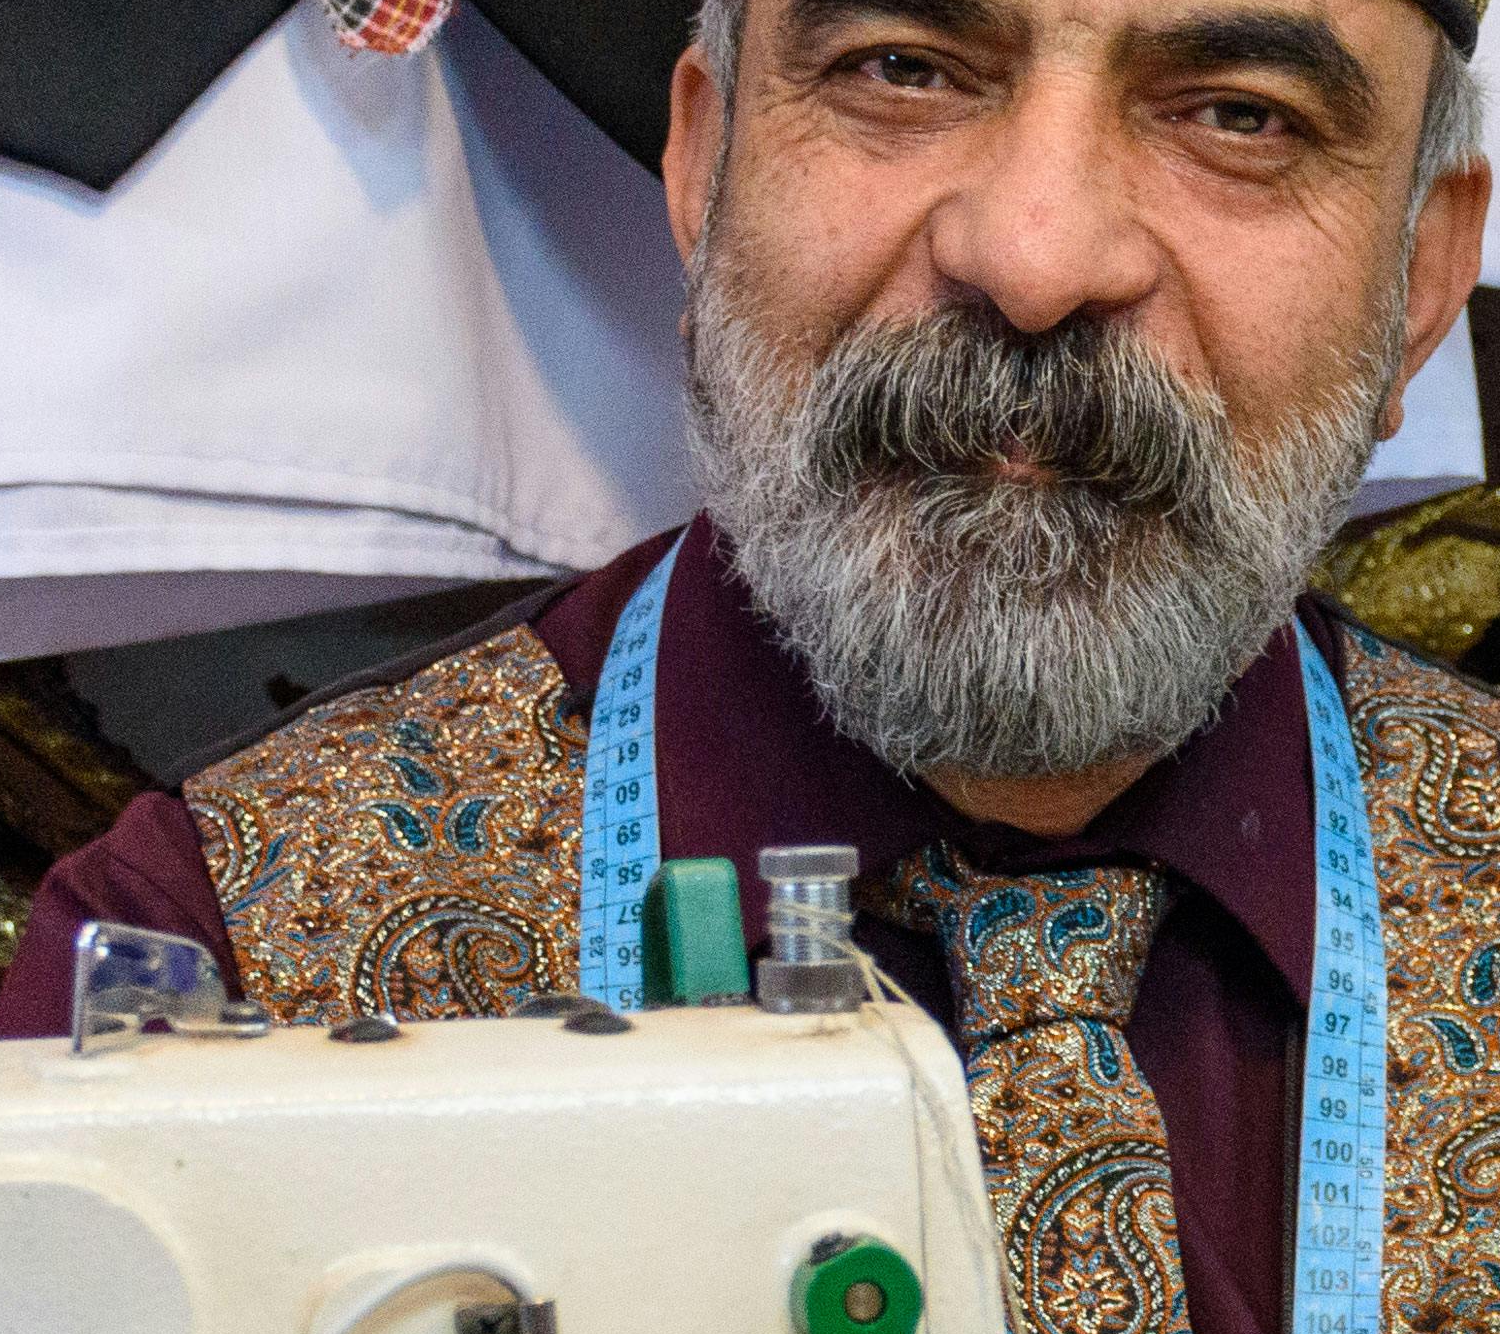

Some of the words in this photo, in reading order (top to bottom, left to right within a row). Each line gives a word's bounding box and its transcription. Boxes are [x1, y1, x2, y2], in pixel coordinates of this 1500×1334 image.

[619, 703, 640, 728] 62
[618, 741, 638, 765] 61
[616, 781, 640, 805] 60
[1329, 810, 1348, 834] 92
[617, 822, 641, 846] 59
[1328, 849, 1349, 874] 93
[619, 863, 643, 886] 58
[1331, 888, 1352, 911] 94
[617, 903, 643, 925] 57
[617, 945, 642, 967] 56
[1329, 969, 1353, 993] 96
[619, 988, 643, 1010] 55
[1325, 1013, 1350, 1036] 97
[1322, 1055, 1348, 1079] 98
[1319, 1097, 1348, 1120] 99
[1311, 1139, 1353, 1162] 100
[1310, 1181, 1350, 1204] 101
[1308, 1225, 1351, 1248] 102
[1306, 1269, 1349, 1292] 103
